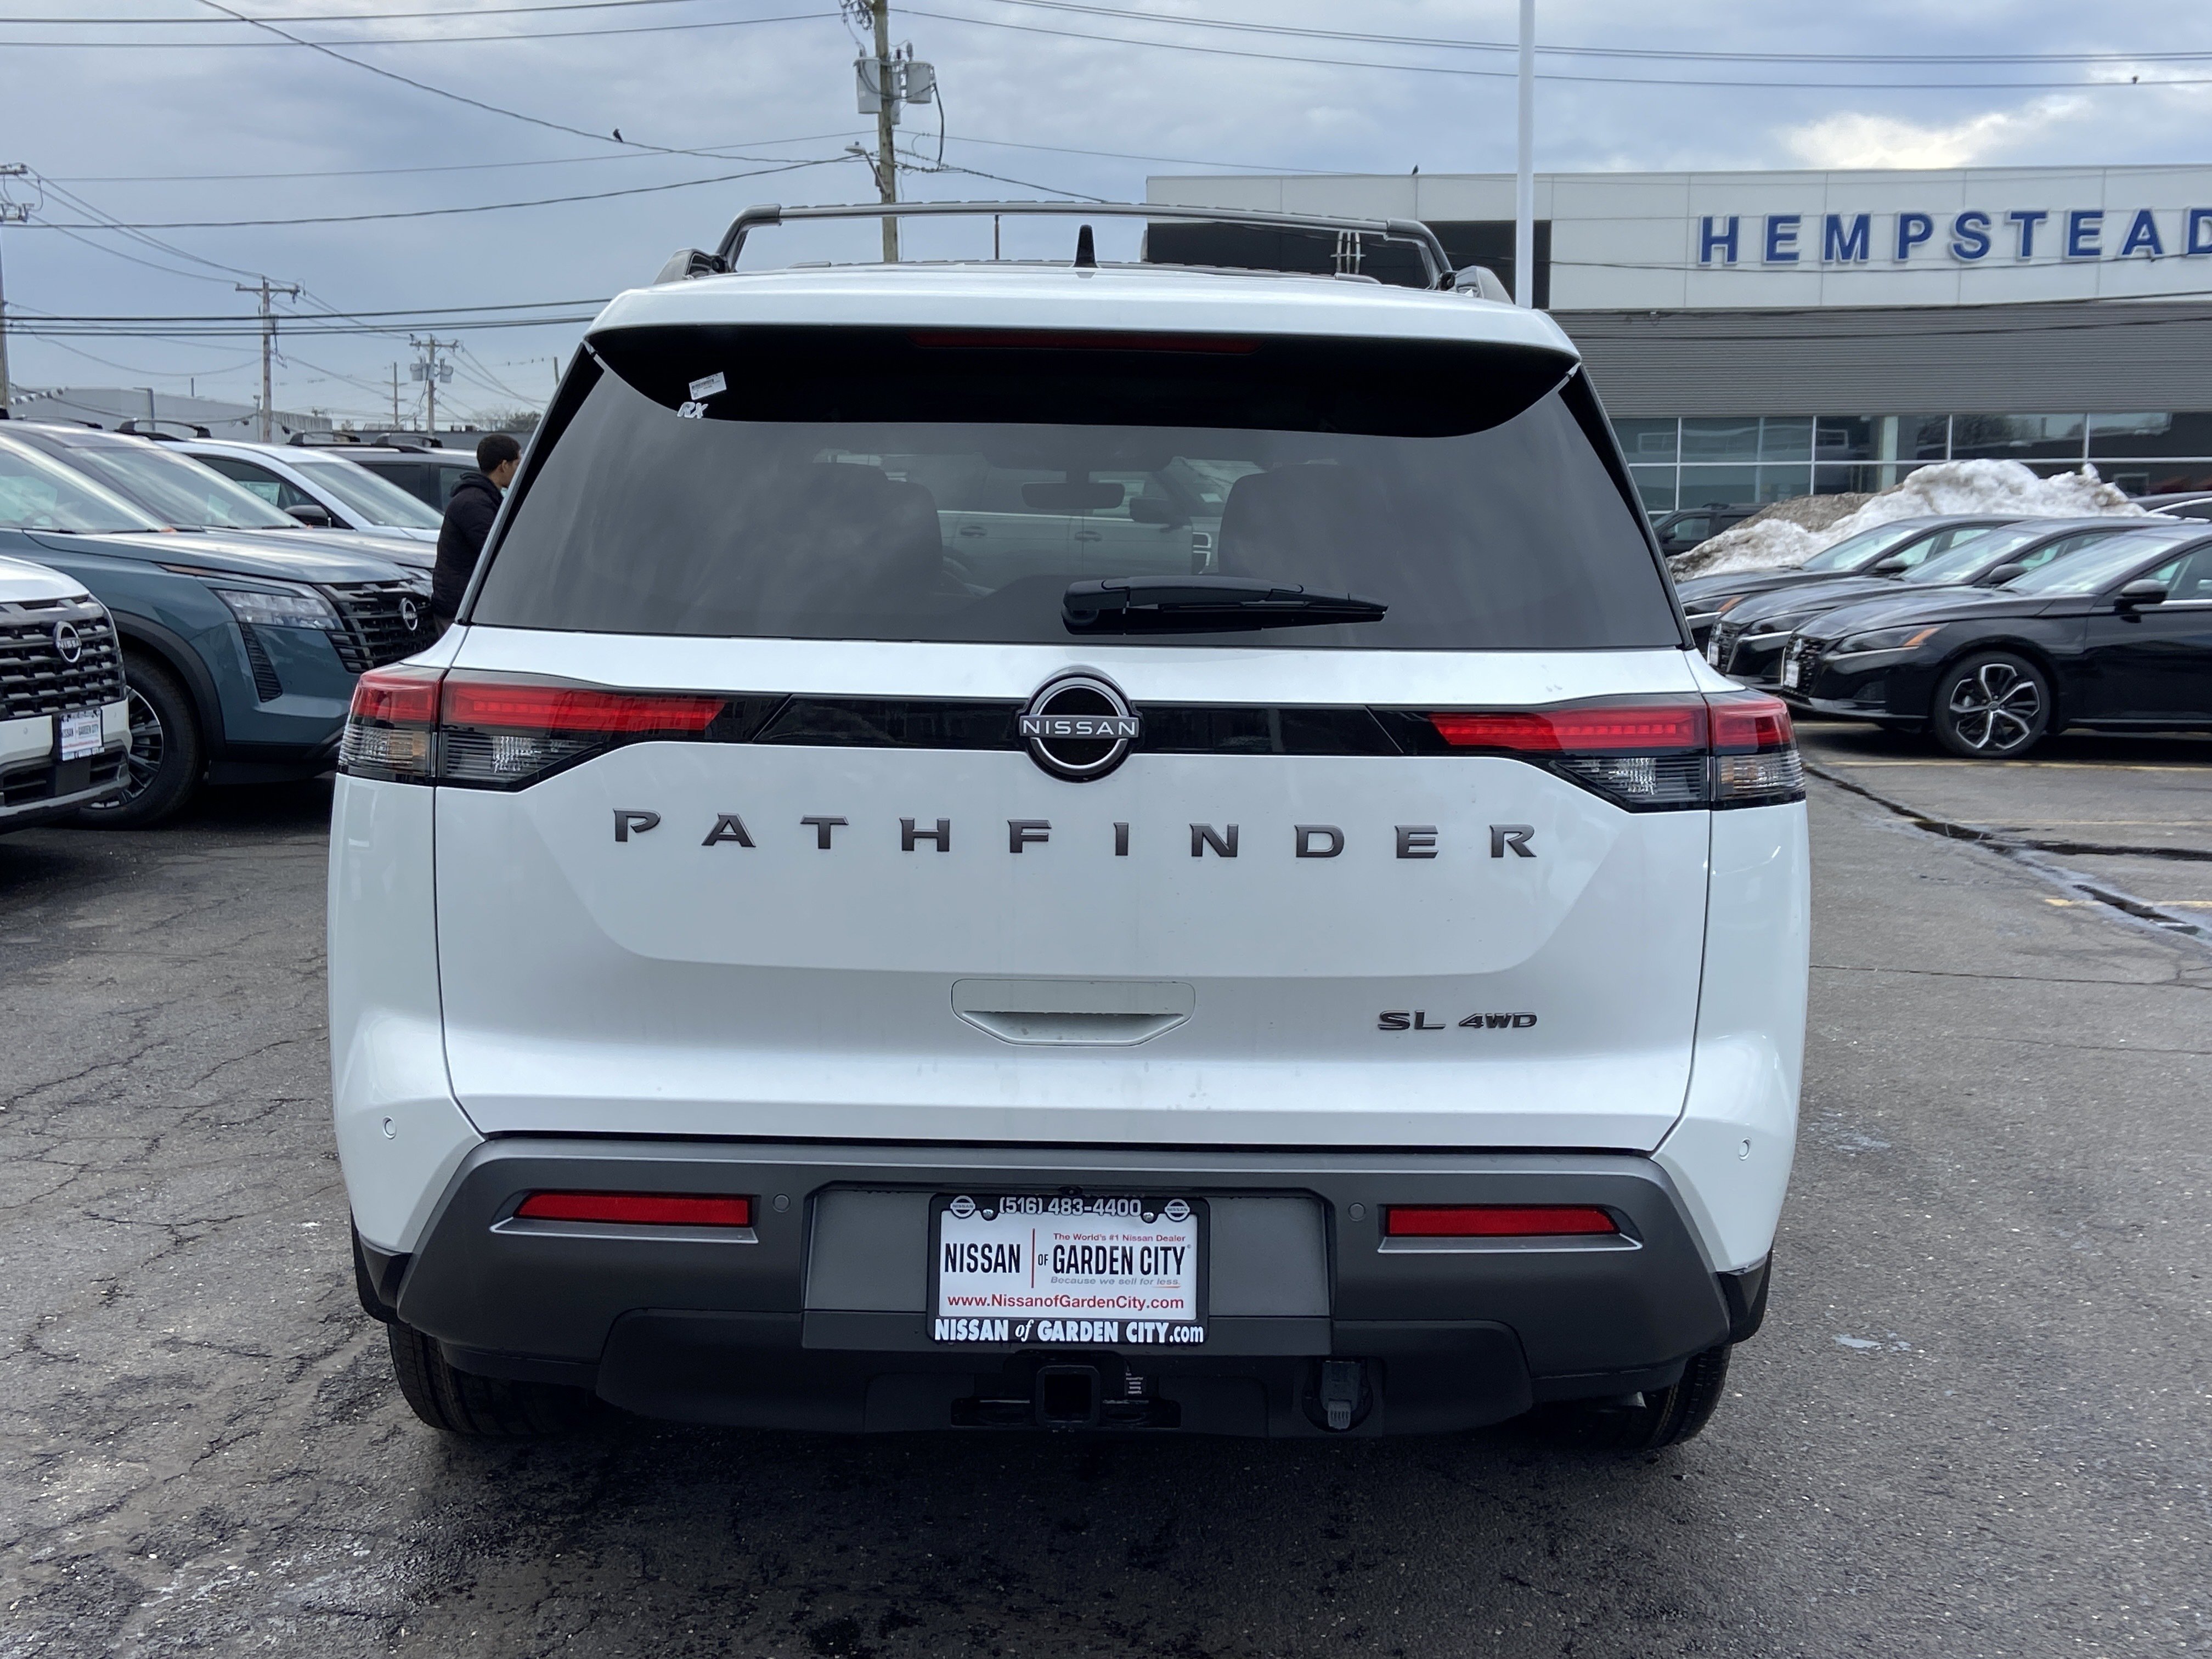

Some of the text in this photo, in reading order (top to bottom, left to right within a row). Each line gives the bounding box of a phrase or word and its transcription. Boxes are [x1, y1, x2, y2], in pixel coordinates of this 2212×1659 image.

[1023, 720, 1135, 735] NISSAN
[613, 808, 1537, 859] PATHFINDER
[1377, 1010, 1537, 1030] SL 4WD
[1000, 1197, 1142, 1216] (516) 483-4400
[1073, 1233, 1107, 1242] World's
[944, 1243, 1021, 1273] NISSAN
[1037, 1244, 1186, 1276] OF GARDEN CITY
[1050, 1276, 1096, 1284] Because
[947, 1294, 1185, 1311] www.NissanofGardenCity.com
[934, 1319, 1204, 1344] NISSAN of GARDEN CITY.com
